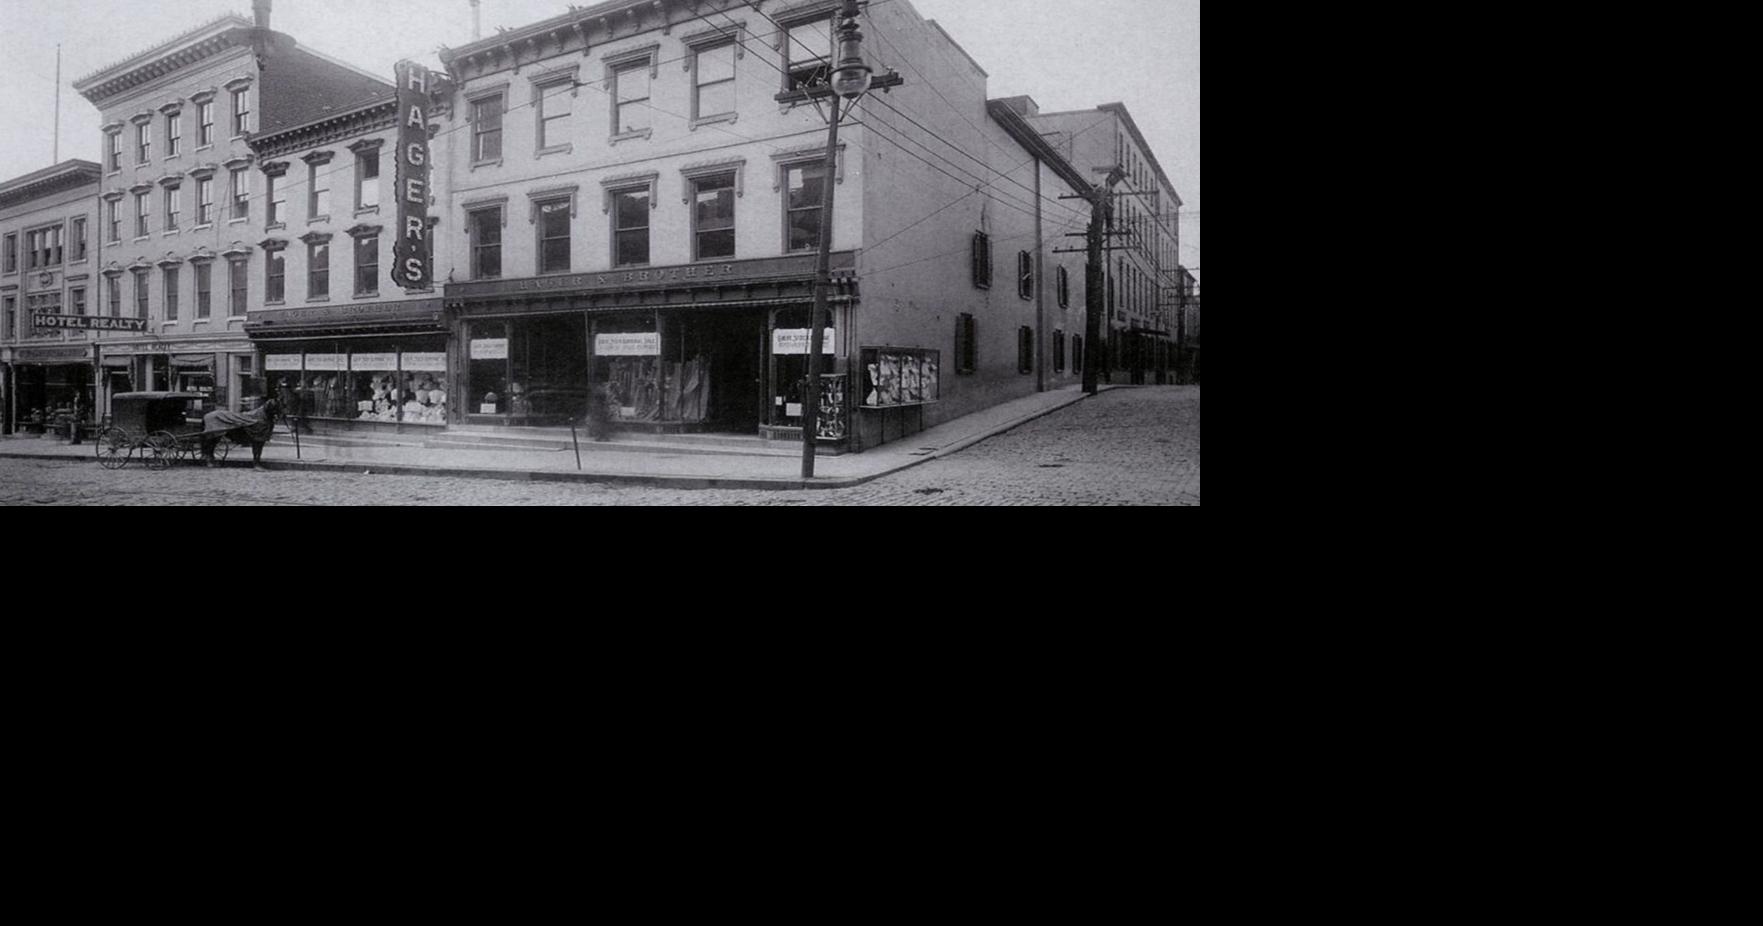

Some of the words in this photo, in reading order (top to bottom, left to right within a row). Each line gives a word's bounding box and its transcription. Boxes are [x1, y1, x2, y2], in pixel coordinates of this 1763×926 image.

[405, 66, 426, 281] HAGER'S
[623, 264, 733, 281] BROTHER
[34, 315, 86, 327] HOTEL
[89, 317, 145, 329] REALTY
